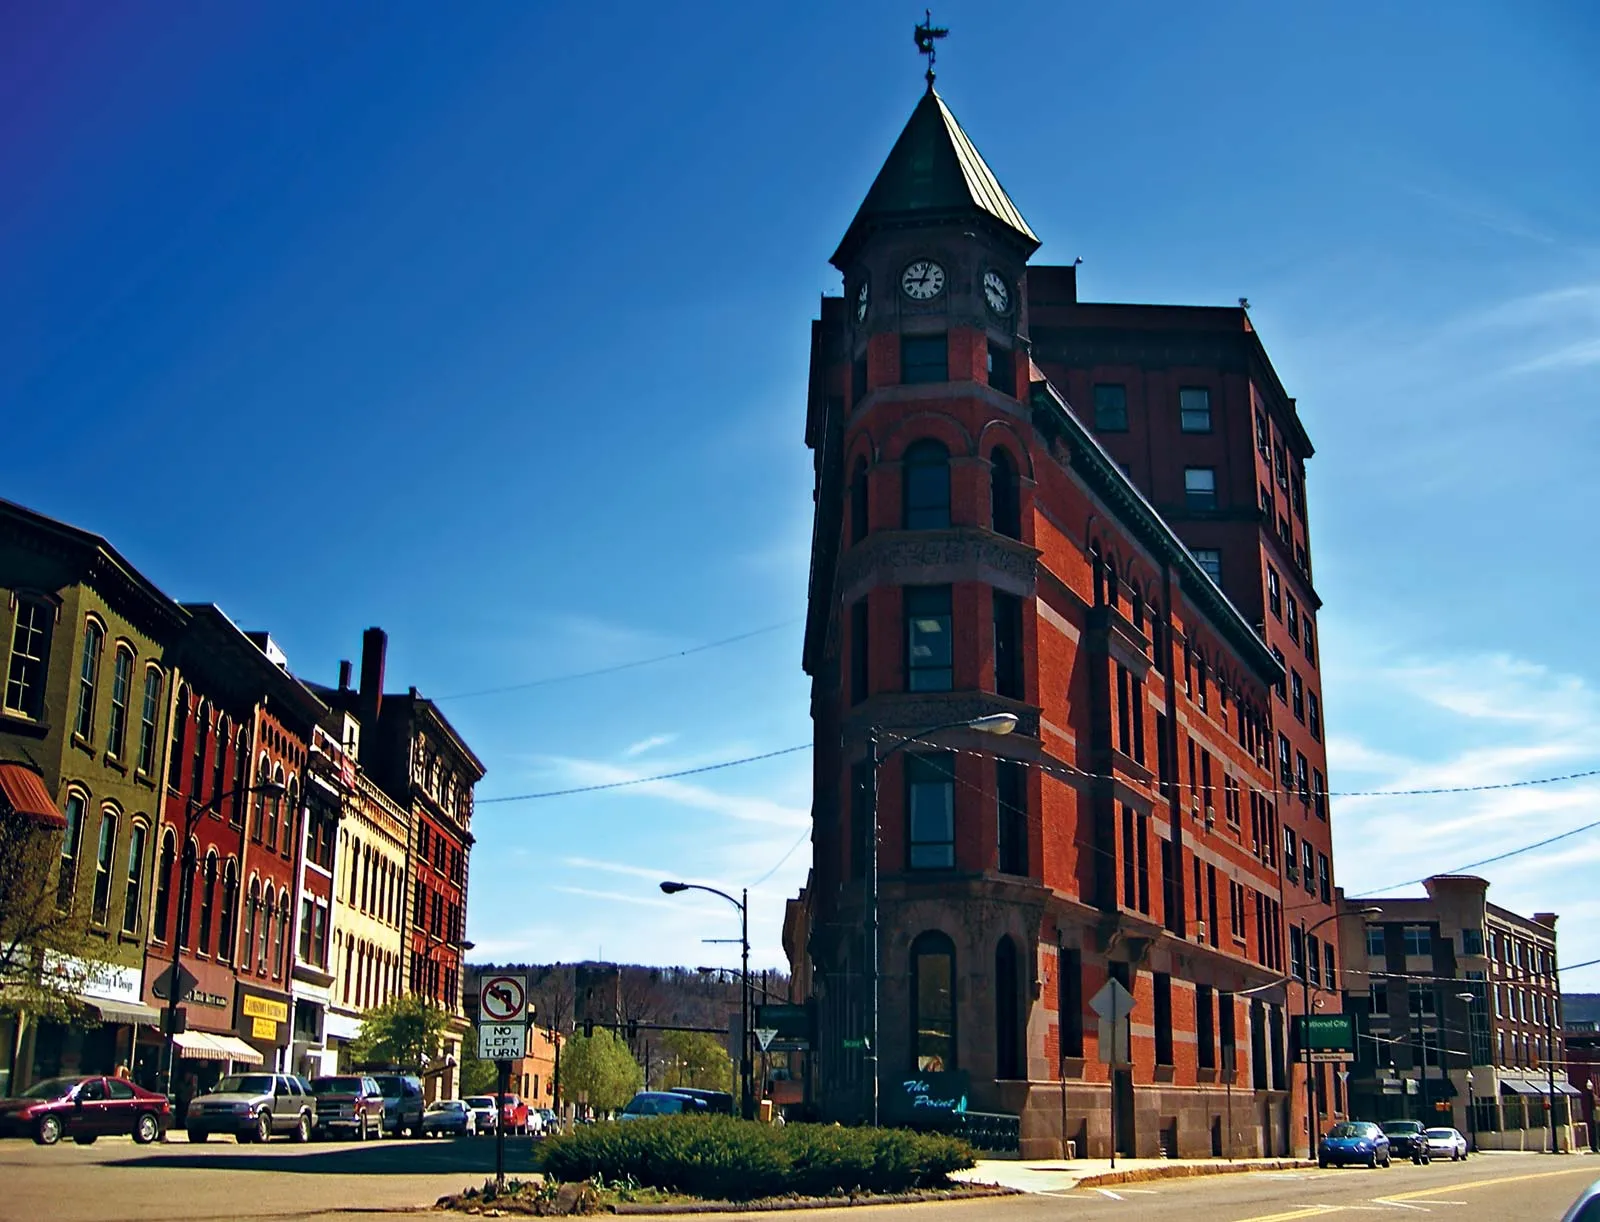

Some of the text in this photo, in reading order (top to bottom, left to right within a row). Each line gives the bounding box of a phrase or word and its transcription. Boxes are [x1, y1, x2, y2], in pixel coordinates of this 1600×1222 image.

[1333, 1019, 1348, 1028] City
[493, 1026, 512, 1035] NO
[485, 1037, 519, 1047] LEFT
[485, 1048, 519, 1057] TURN
[903, 1080, 930, 1093] The
[913, 1095, 955, 1108] Point
